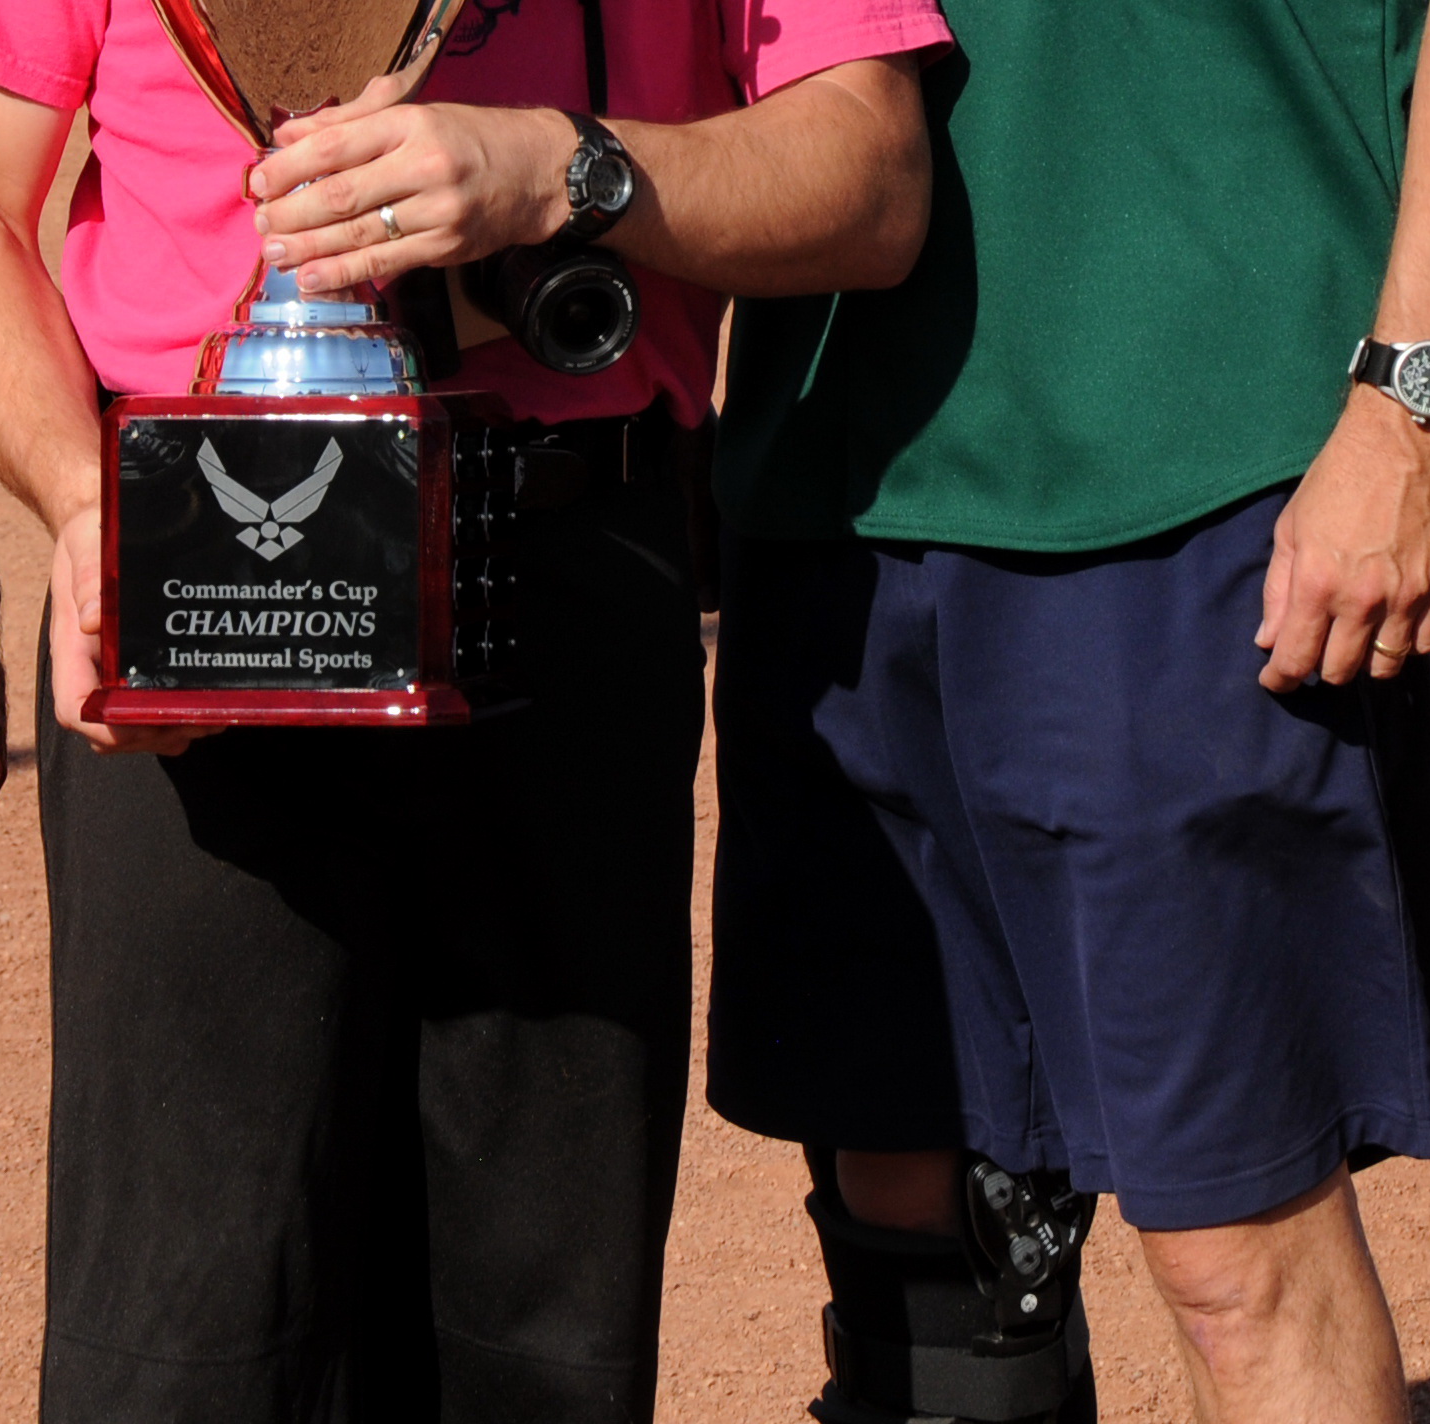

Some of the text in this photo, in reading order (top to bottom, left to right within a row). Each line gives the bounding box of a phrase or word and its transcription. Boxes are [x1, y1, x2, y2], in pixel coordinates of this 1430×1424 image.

[162, 578, 379, 606] Commander's Cup
[164, 610, 377, 638] CHAMPIONS
[168, 647, 373, 674] Intramural Sports
